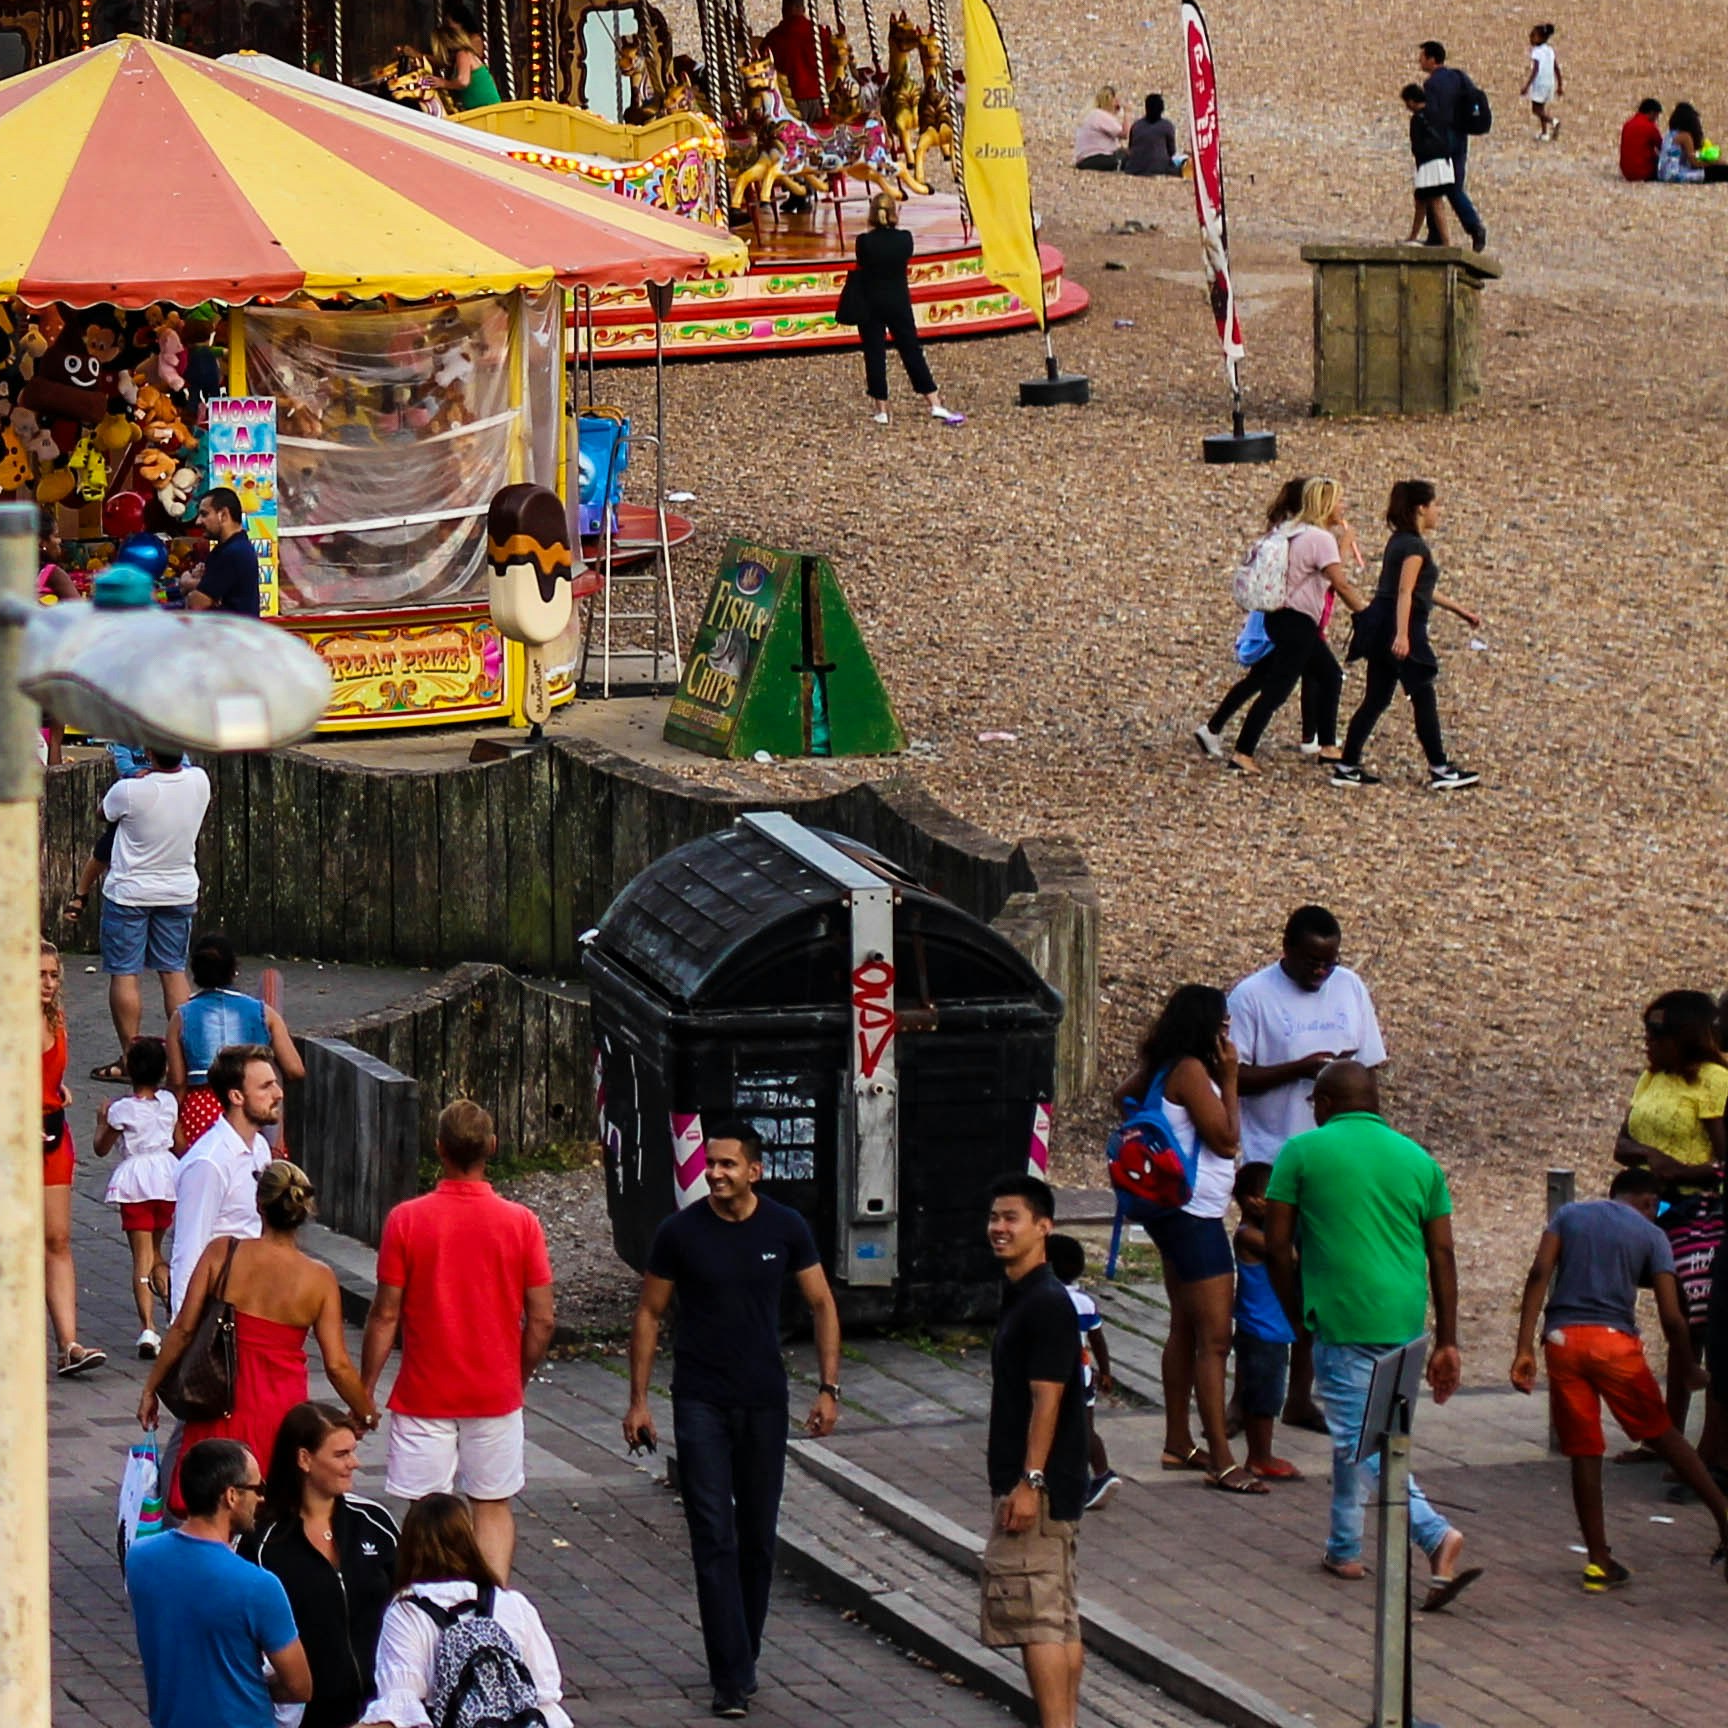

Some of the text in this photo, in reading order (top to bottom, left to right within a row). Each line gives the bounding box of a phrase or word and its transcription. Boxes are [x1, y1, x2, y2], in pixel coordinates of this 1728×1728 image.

[211, 399, 274, 422] HOOK
[232, 425, 253, 450] A
[213, 453, 277, 477] DUCK
[706, 580, 768, 642] FISH &
[400, 646, 472, 676] PRIZES
[687, 652, 740, 708] CHIPS
